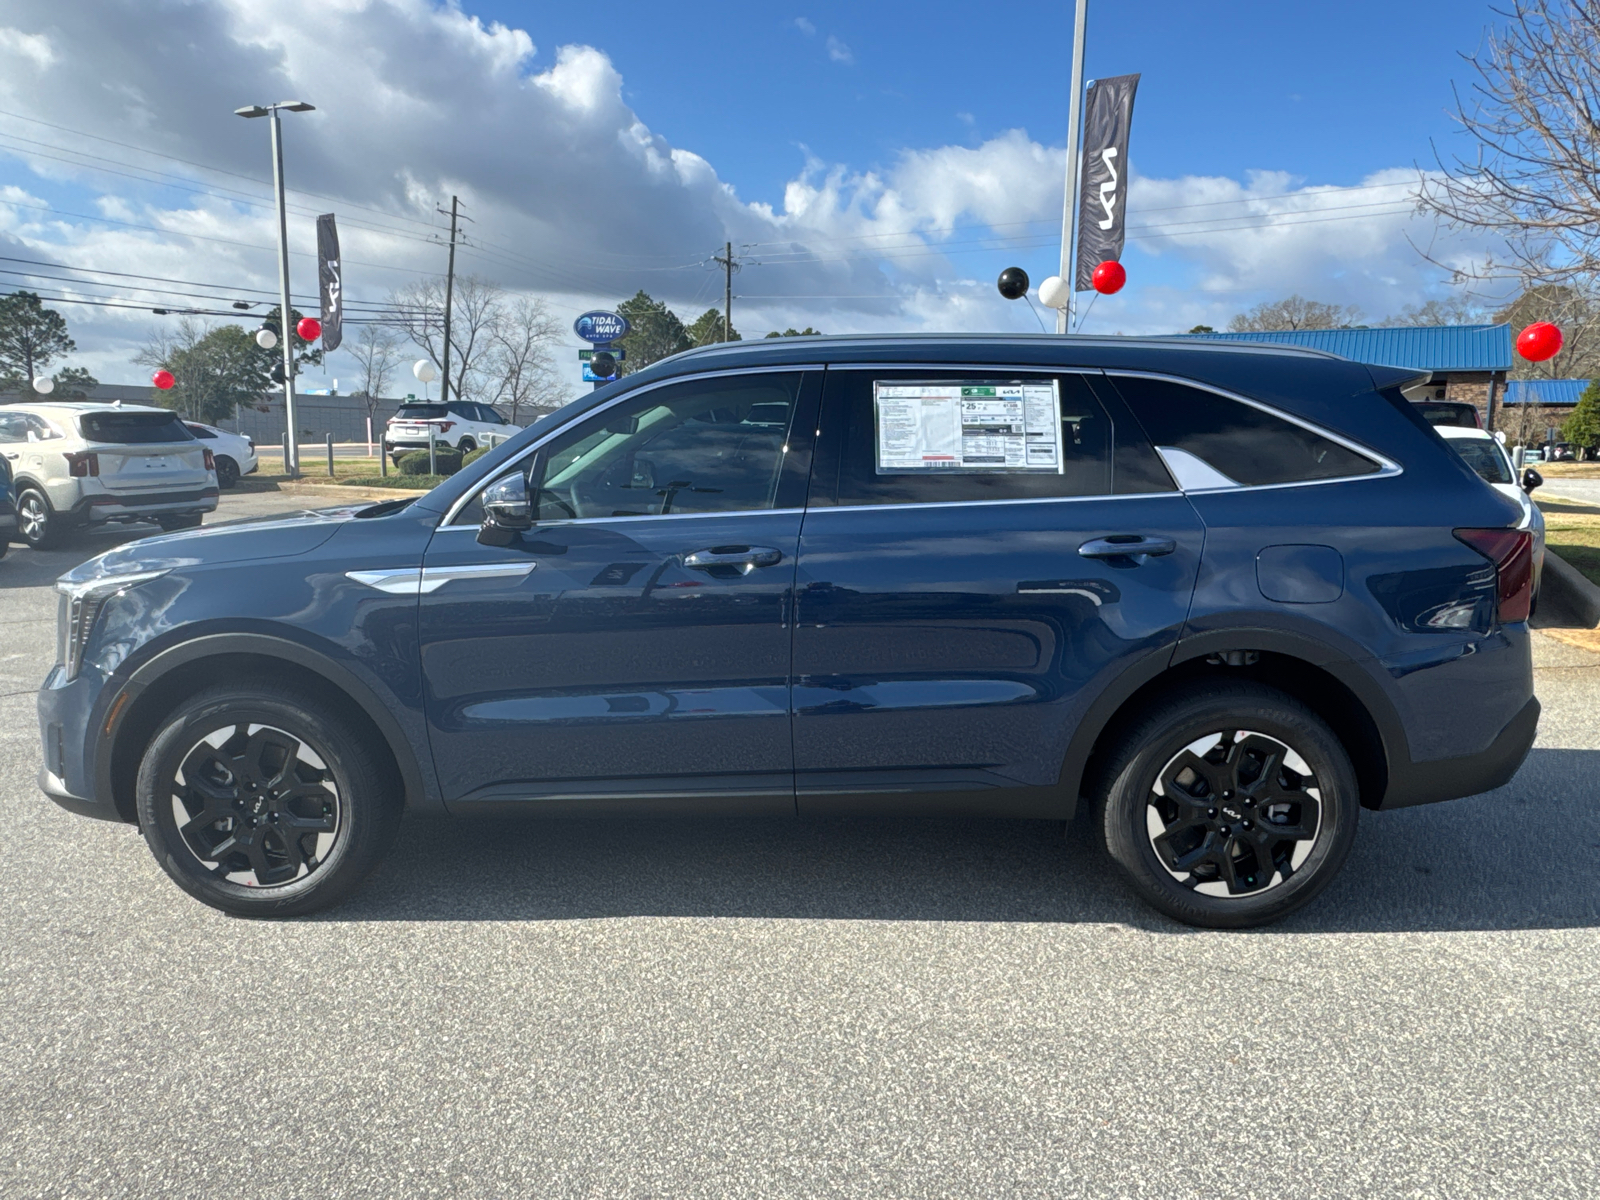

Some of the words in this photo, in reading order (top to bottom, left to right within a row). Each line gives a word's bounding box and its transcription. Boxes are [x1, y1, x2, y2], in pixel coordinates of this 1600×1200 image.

[1098, 146, 1118, 230] KIA
[327, 260, 340, 313] KIA
[592, 316, 616, 325] TIDAL
[596, 325, 621, 334] WAVE
[1222, 807, 1242, 819] KIA
